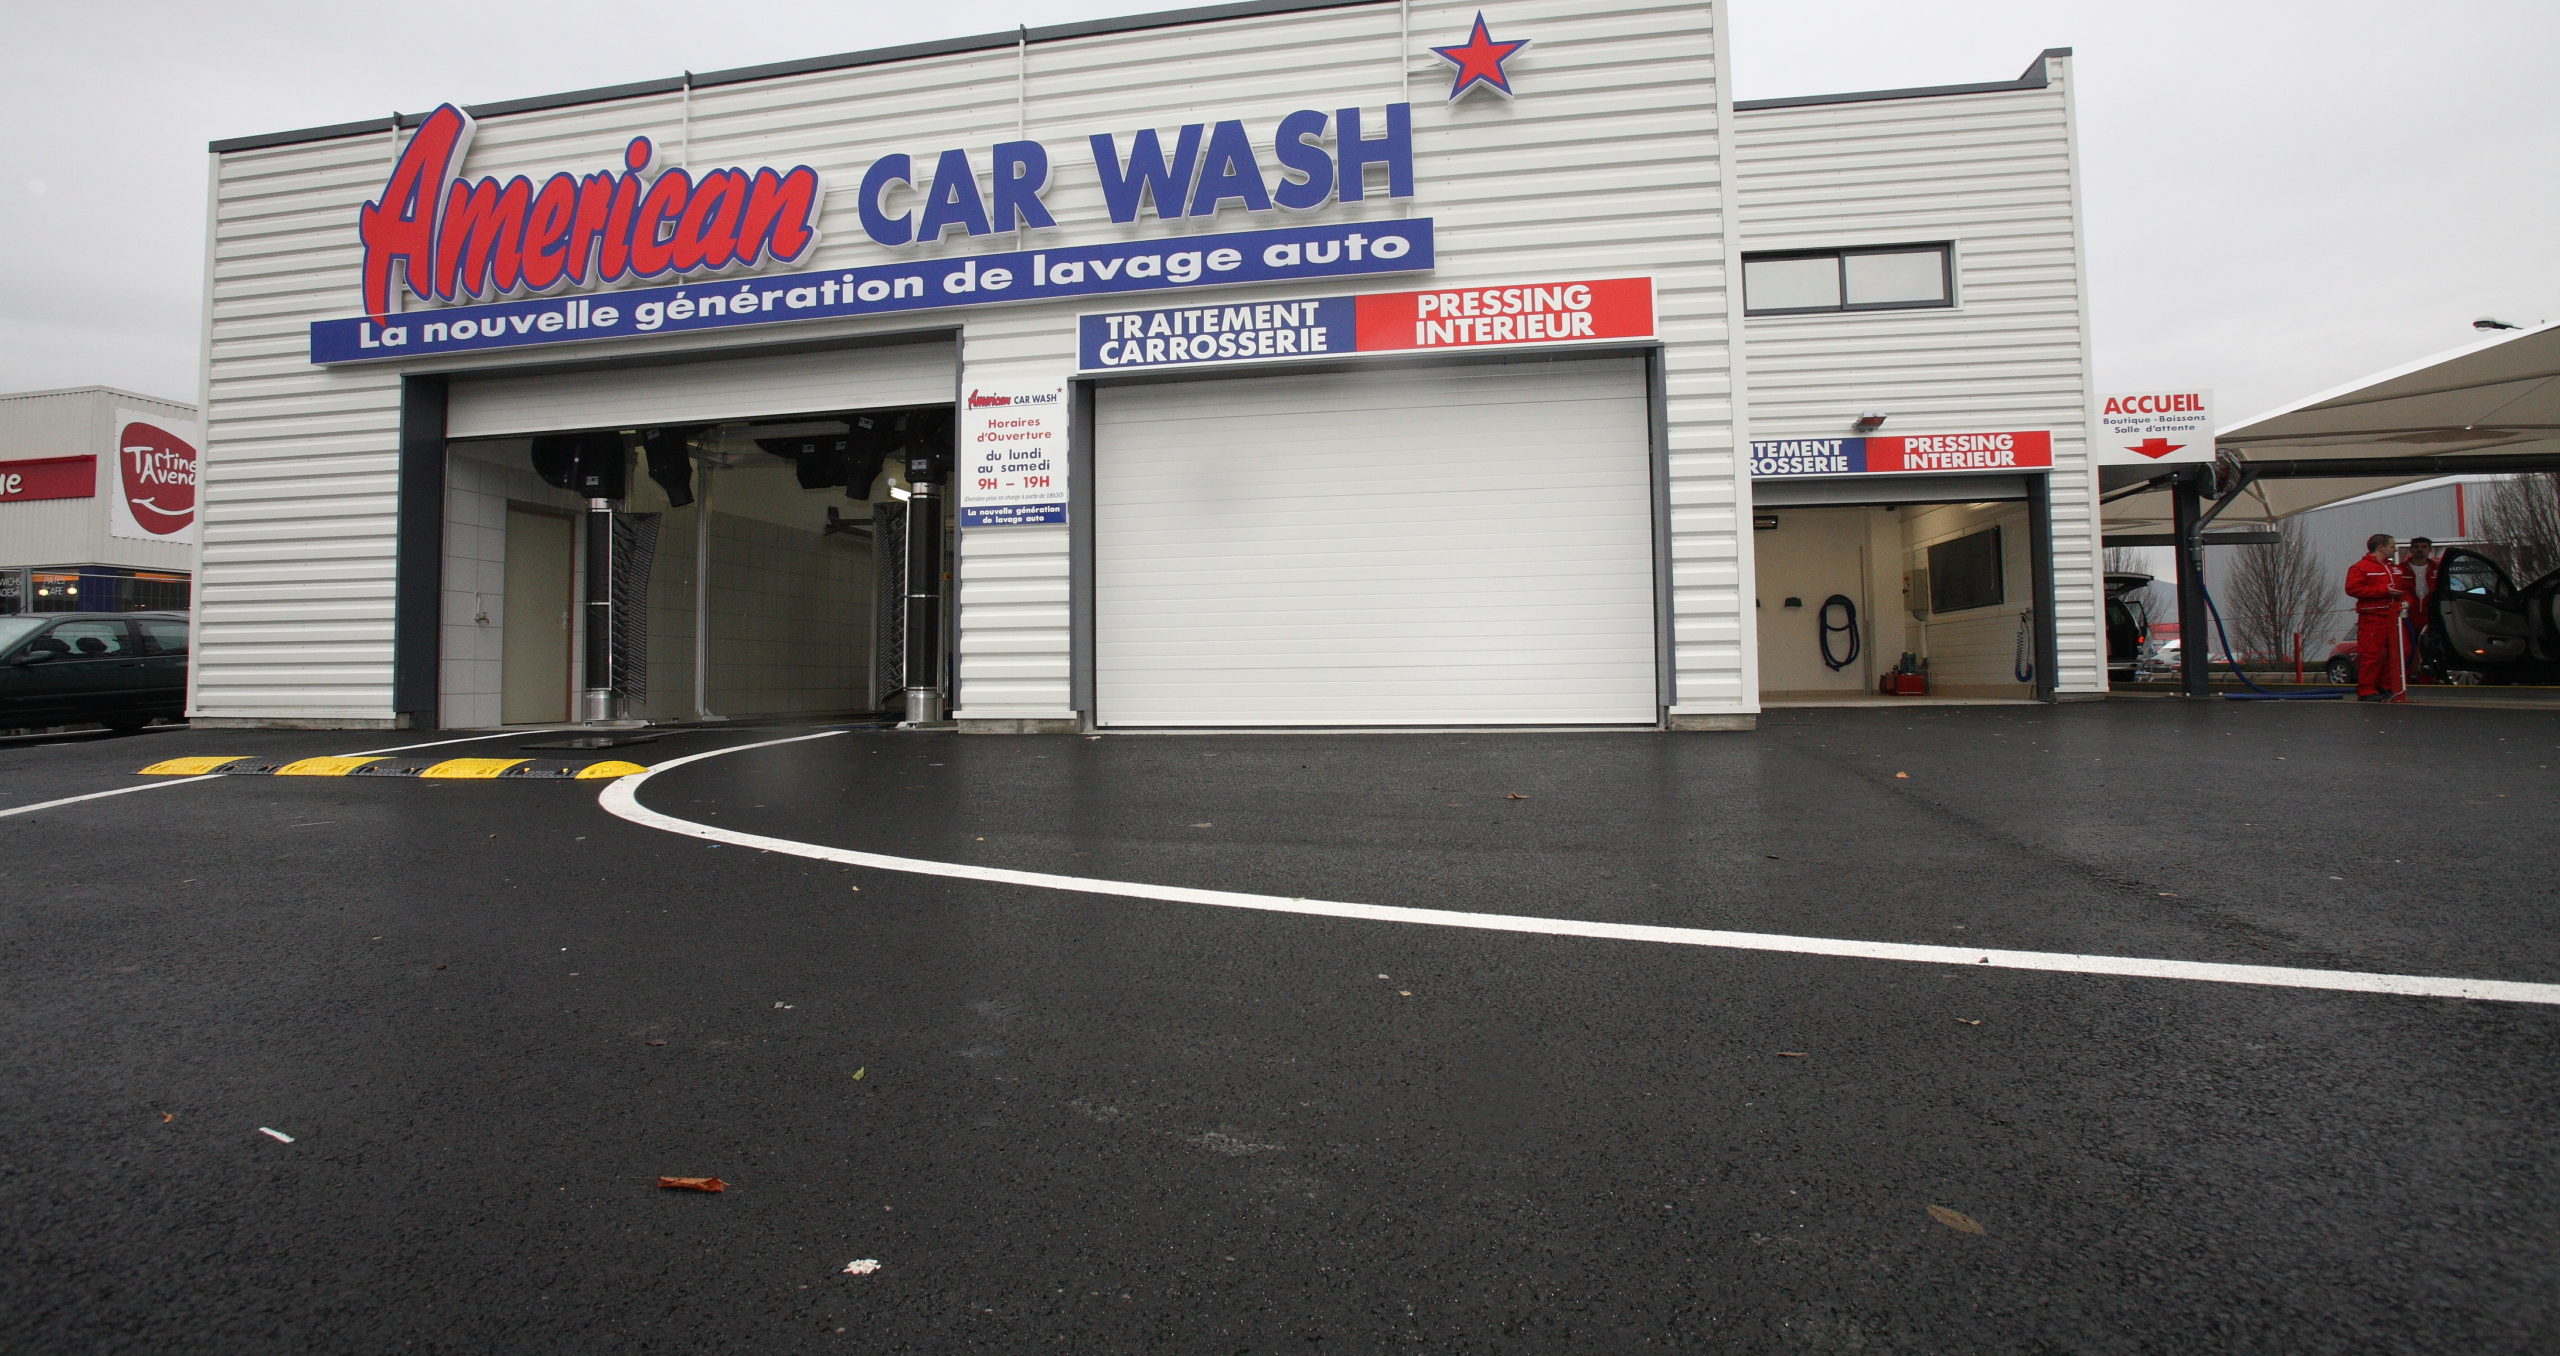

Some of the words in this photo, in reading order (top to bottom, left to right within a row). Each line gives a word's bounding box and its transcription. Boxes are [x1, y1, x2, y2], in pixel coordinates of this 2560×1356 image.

[360, 102, 820, 327] American
[858, 139, 1057, 246] CAR
[1089, 102, 1415, 224] WASH
[360, 322, 407, 349] La
[423, 300, 620, 343] nouvelle
[636, 269, 924, 331] génération
[943, 260, 1013, 295] de
[1034, 237, 1243, 287] lavage
[1263, 231, 1411, 268] auto
[1417, 284, 1592, 320] PRESSING
[1105, 301, 1320, 340] TRAITEMENT
[1416, 311, 1596, 346] INTERIEUR
[1100, 326, 1328, 366] CARROSSERIE
[968, 389, 1011, 410] American
[1014, 395, 1030, 405] CAR
[1032, 393, 1057, 403] WASH
[2103, 393, 2205, 415] ACCUEIL
[988, 417, 1041, 429] Horaires
[2103, 416, 2151, 425] Boutique
[2159, 415, 2206, 423] Boissons
[2114, 426, 2140, 434] Salle
[2146, 424, 2196, 433] d'attente
[977, 431, 1052, 443] d'Ouverture
[1904, 433, 2014, 453] PRESSING
[986, 449, 1002, 461] du
[1009, 448, 1042, 460] lundi
[1904, 450, 2016, 470] INTERIEUR
[977, 465, 993, 474] au
[1001, 460, 1051, 473] samedi
[977, 477, 998, 490] 9H
[1023, 476, 1050, 489] 19H
[979, 507, 1013, 515] nouvelle
[1016, 505, 1060, 515] génération
[982, 516, 992, 524] de
[995, 516, 1023, 524] lavage
